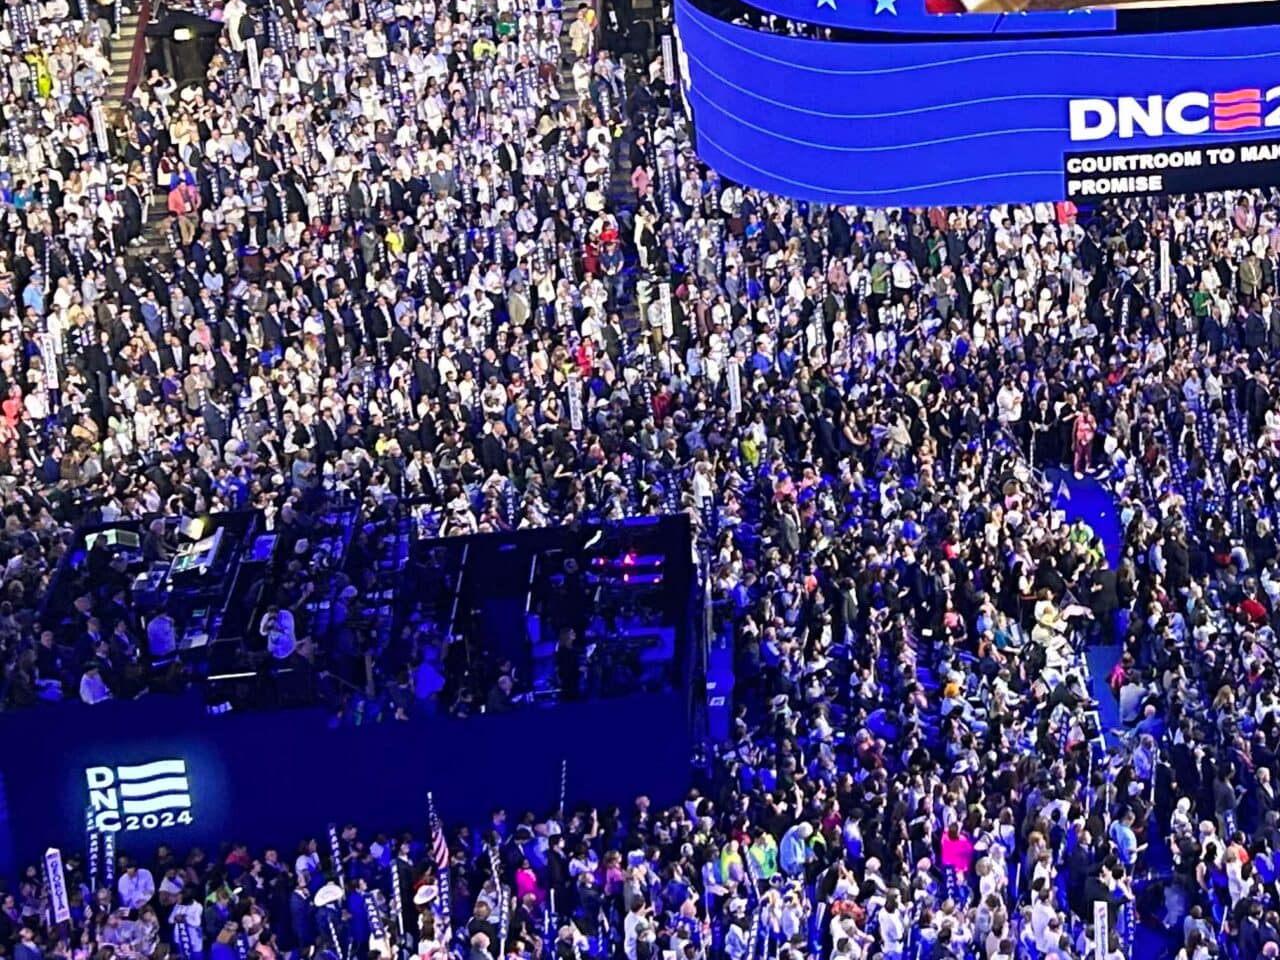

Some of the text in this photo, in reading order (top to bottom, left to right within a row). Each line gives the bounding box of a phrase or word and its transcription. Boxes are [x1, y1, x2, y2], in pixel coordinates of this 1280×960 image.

[1066, 149, 1203, 175] COURTROOM
[1206, 148, 1235, 165] TO
[1067, 174, 1163, 197] PROMISE
[125, 810, 194, 832] 2024
